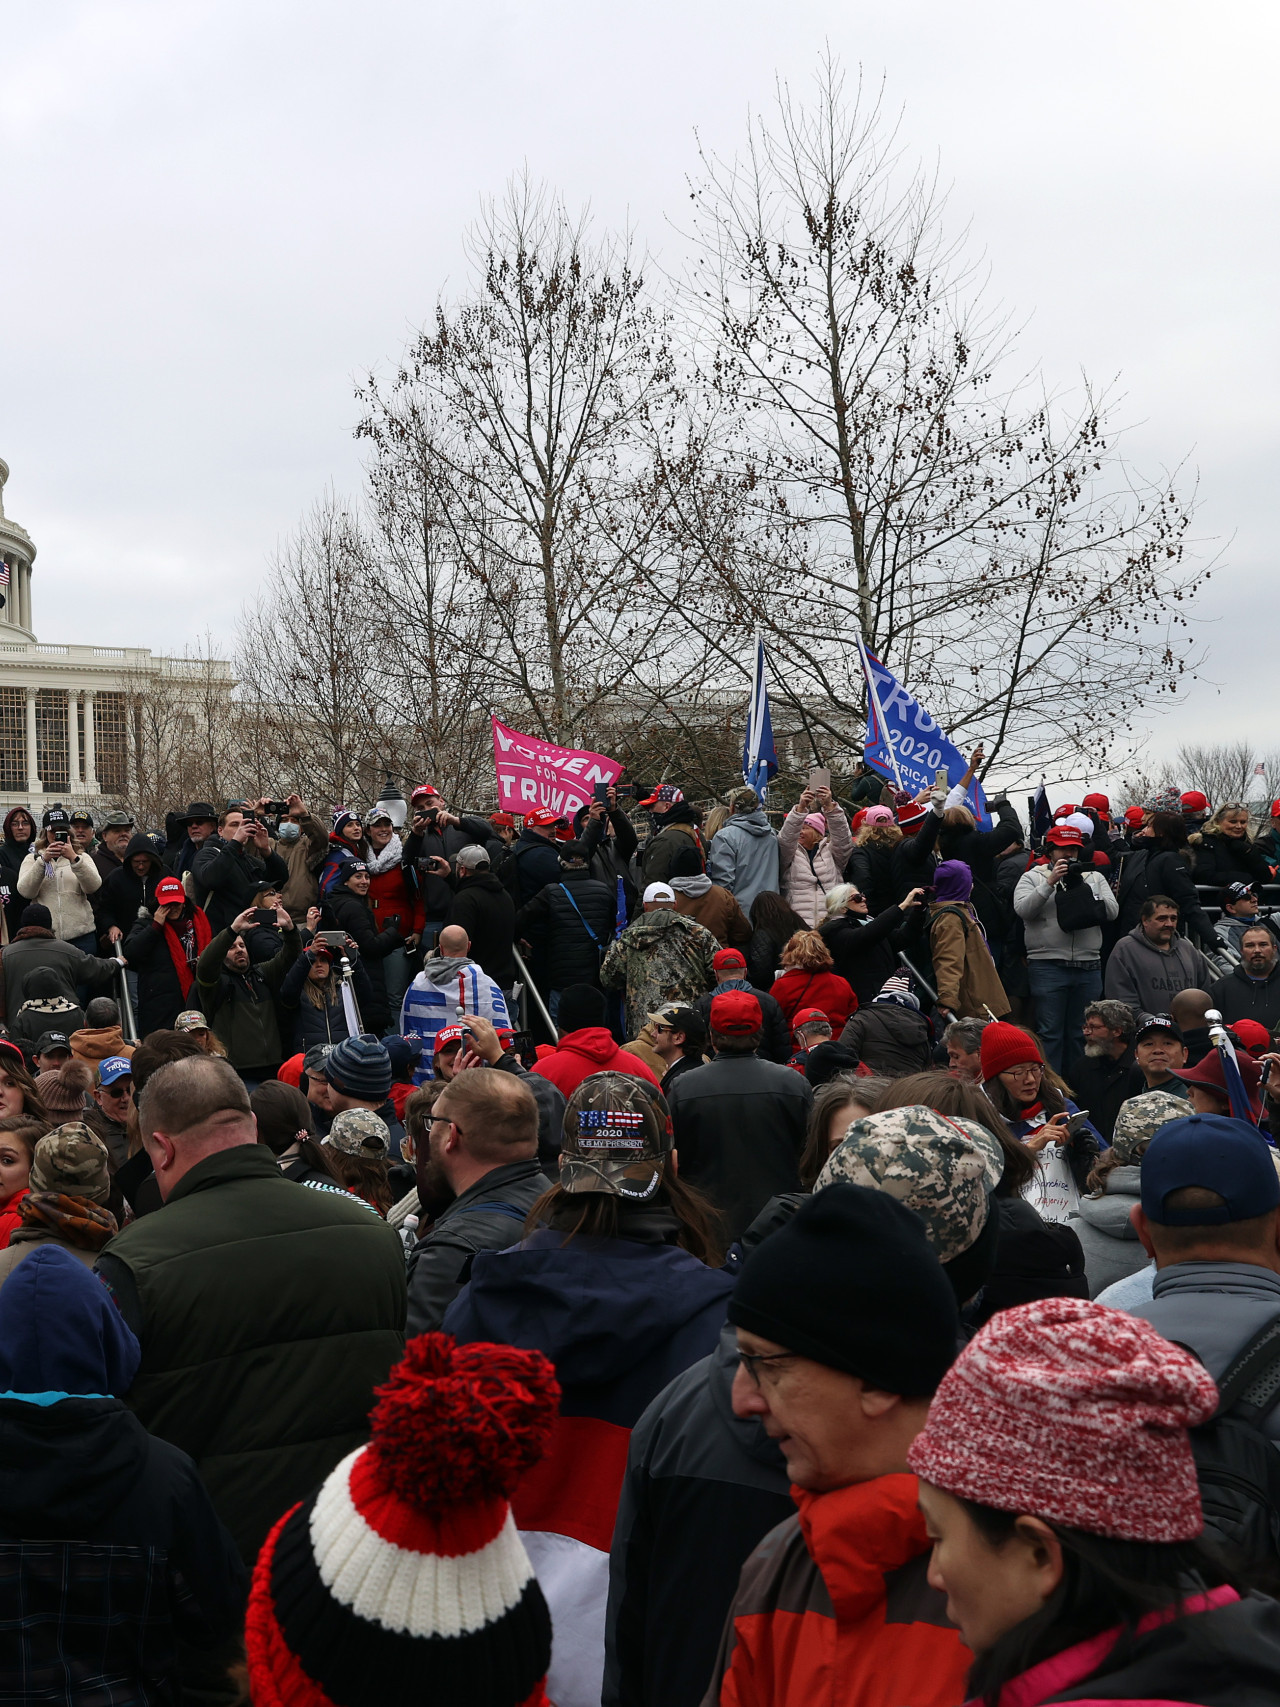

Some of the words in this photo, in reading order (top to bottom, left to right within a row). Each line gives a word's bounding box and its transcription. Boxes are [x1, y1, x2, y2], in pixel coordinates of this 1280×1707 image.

[535, 765, 557, 783] FOR
[500, 774, 584, 816] TRUMP
[577, 1110, 644, 1129] TRUMP
[596, 1129, 623, 1137] 2020
[605, 1140, 644, 1148] PRESIDENT
